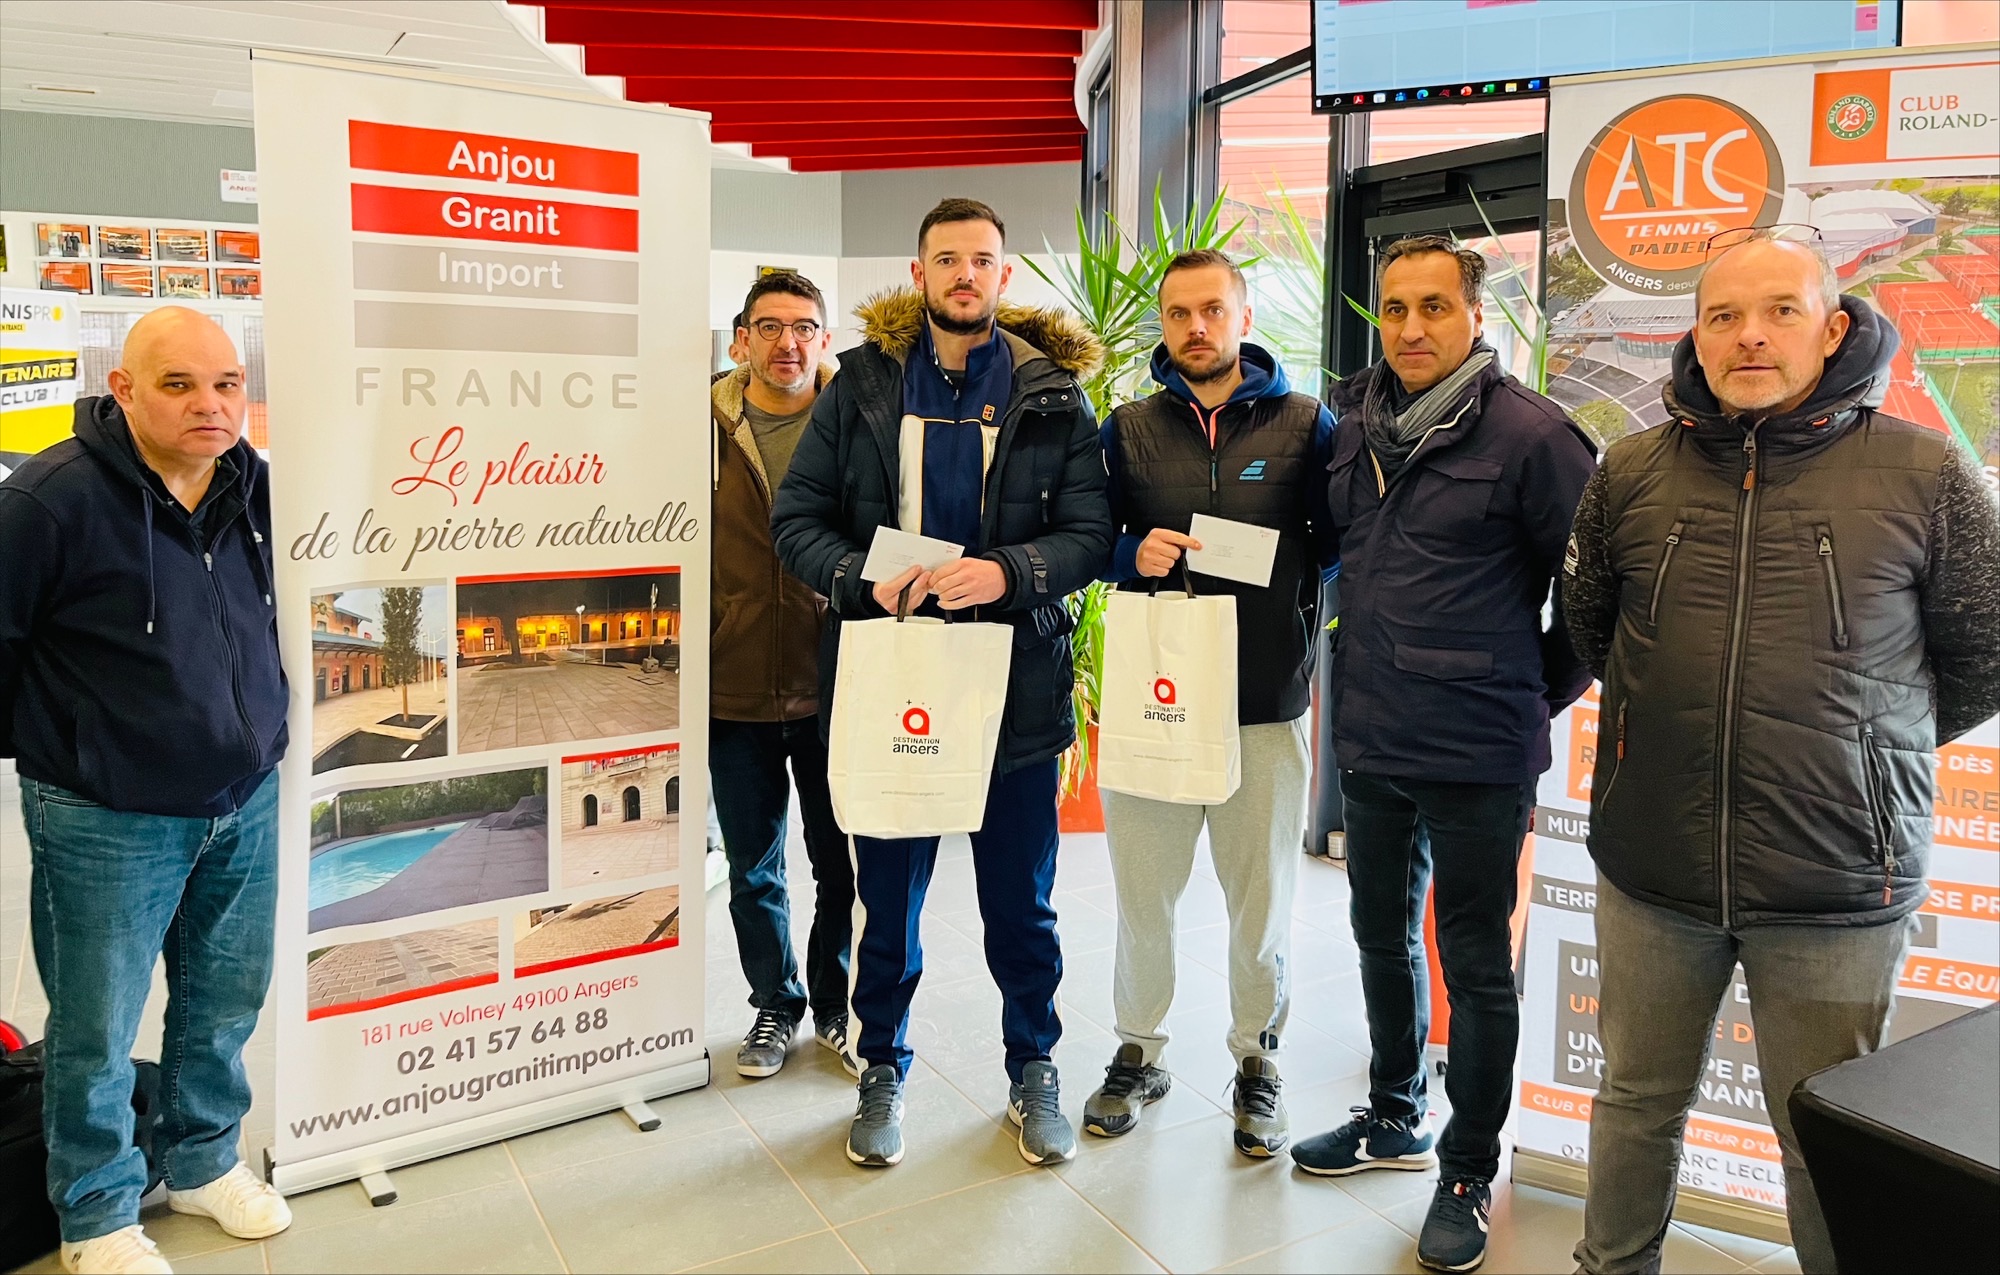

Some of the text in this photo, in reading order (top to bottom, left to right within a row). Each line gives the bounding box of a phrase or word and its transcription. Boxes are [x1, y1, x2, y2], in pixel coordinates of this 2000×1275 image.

[1900, 94, 1959, 112] CLUB
[448, 141, 556, 183] Anjou
[1604, 128, 1749, 212] ATC
[441, 197, 561, 237] Granit
[1624, 221, 1719, 238] TENNIS
[1628, 240, 1708, 256] PADEL
[438, 251, 564, 292] Import
[1606, 262, 1663, 291] ANGERS
[1, 388, 48, 406] CLUB
[356, 367, 639, 410] FRANCE
[391, 426, 607, 507] Le plaisir
[290, 501, 699, 572] de la pierre naturelle
[1144, 704, 1186, 713] DESTINATION
[893, 737, 940, 745] DESTINATION
[1948, 753, 1994, 775] DÈS
[361, 975, 639, 1046] 181 rue Volney 49100 Angers
[398, 1007, 608, 1075] 02 41 57 64 88
[290, 1027, 694, 1138] www.anjougranitimport.com
[1532, 1093, 1574, 1112] CLUB
[1561, 1144, 1585, 1161] 02
